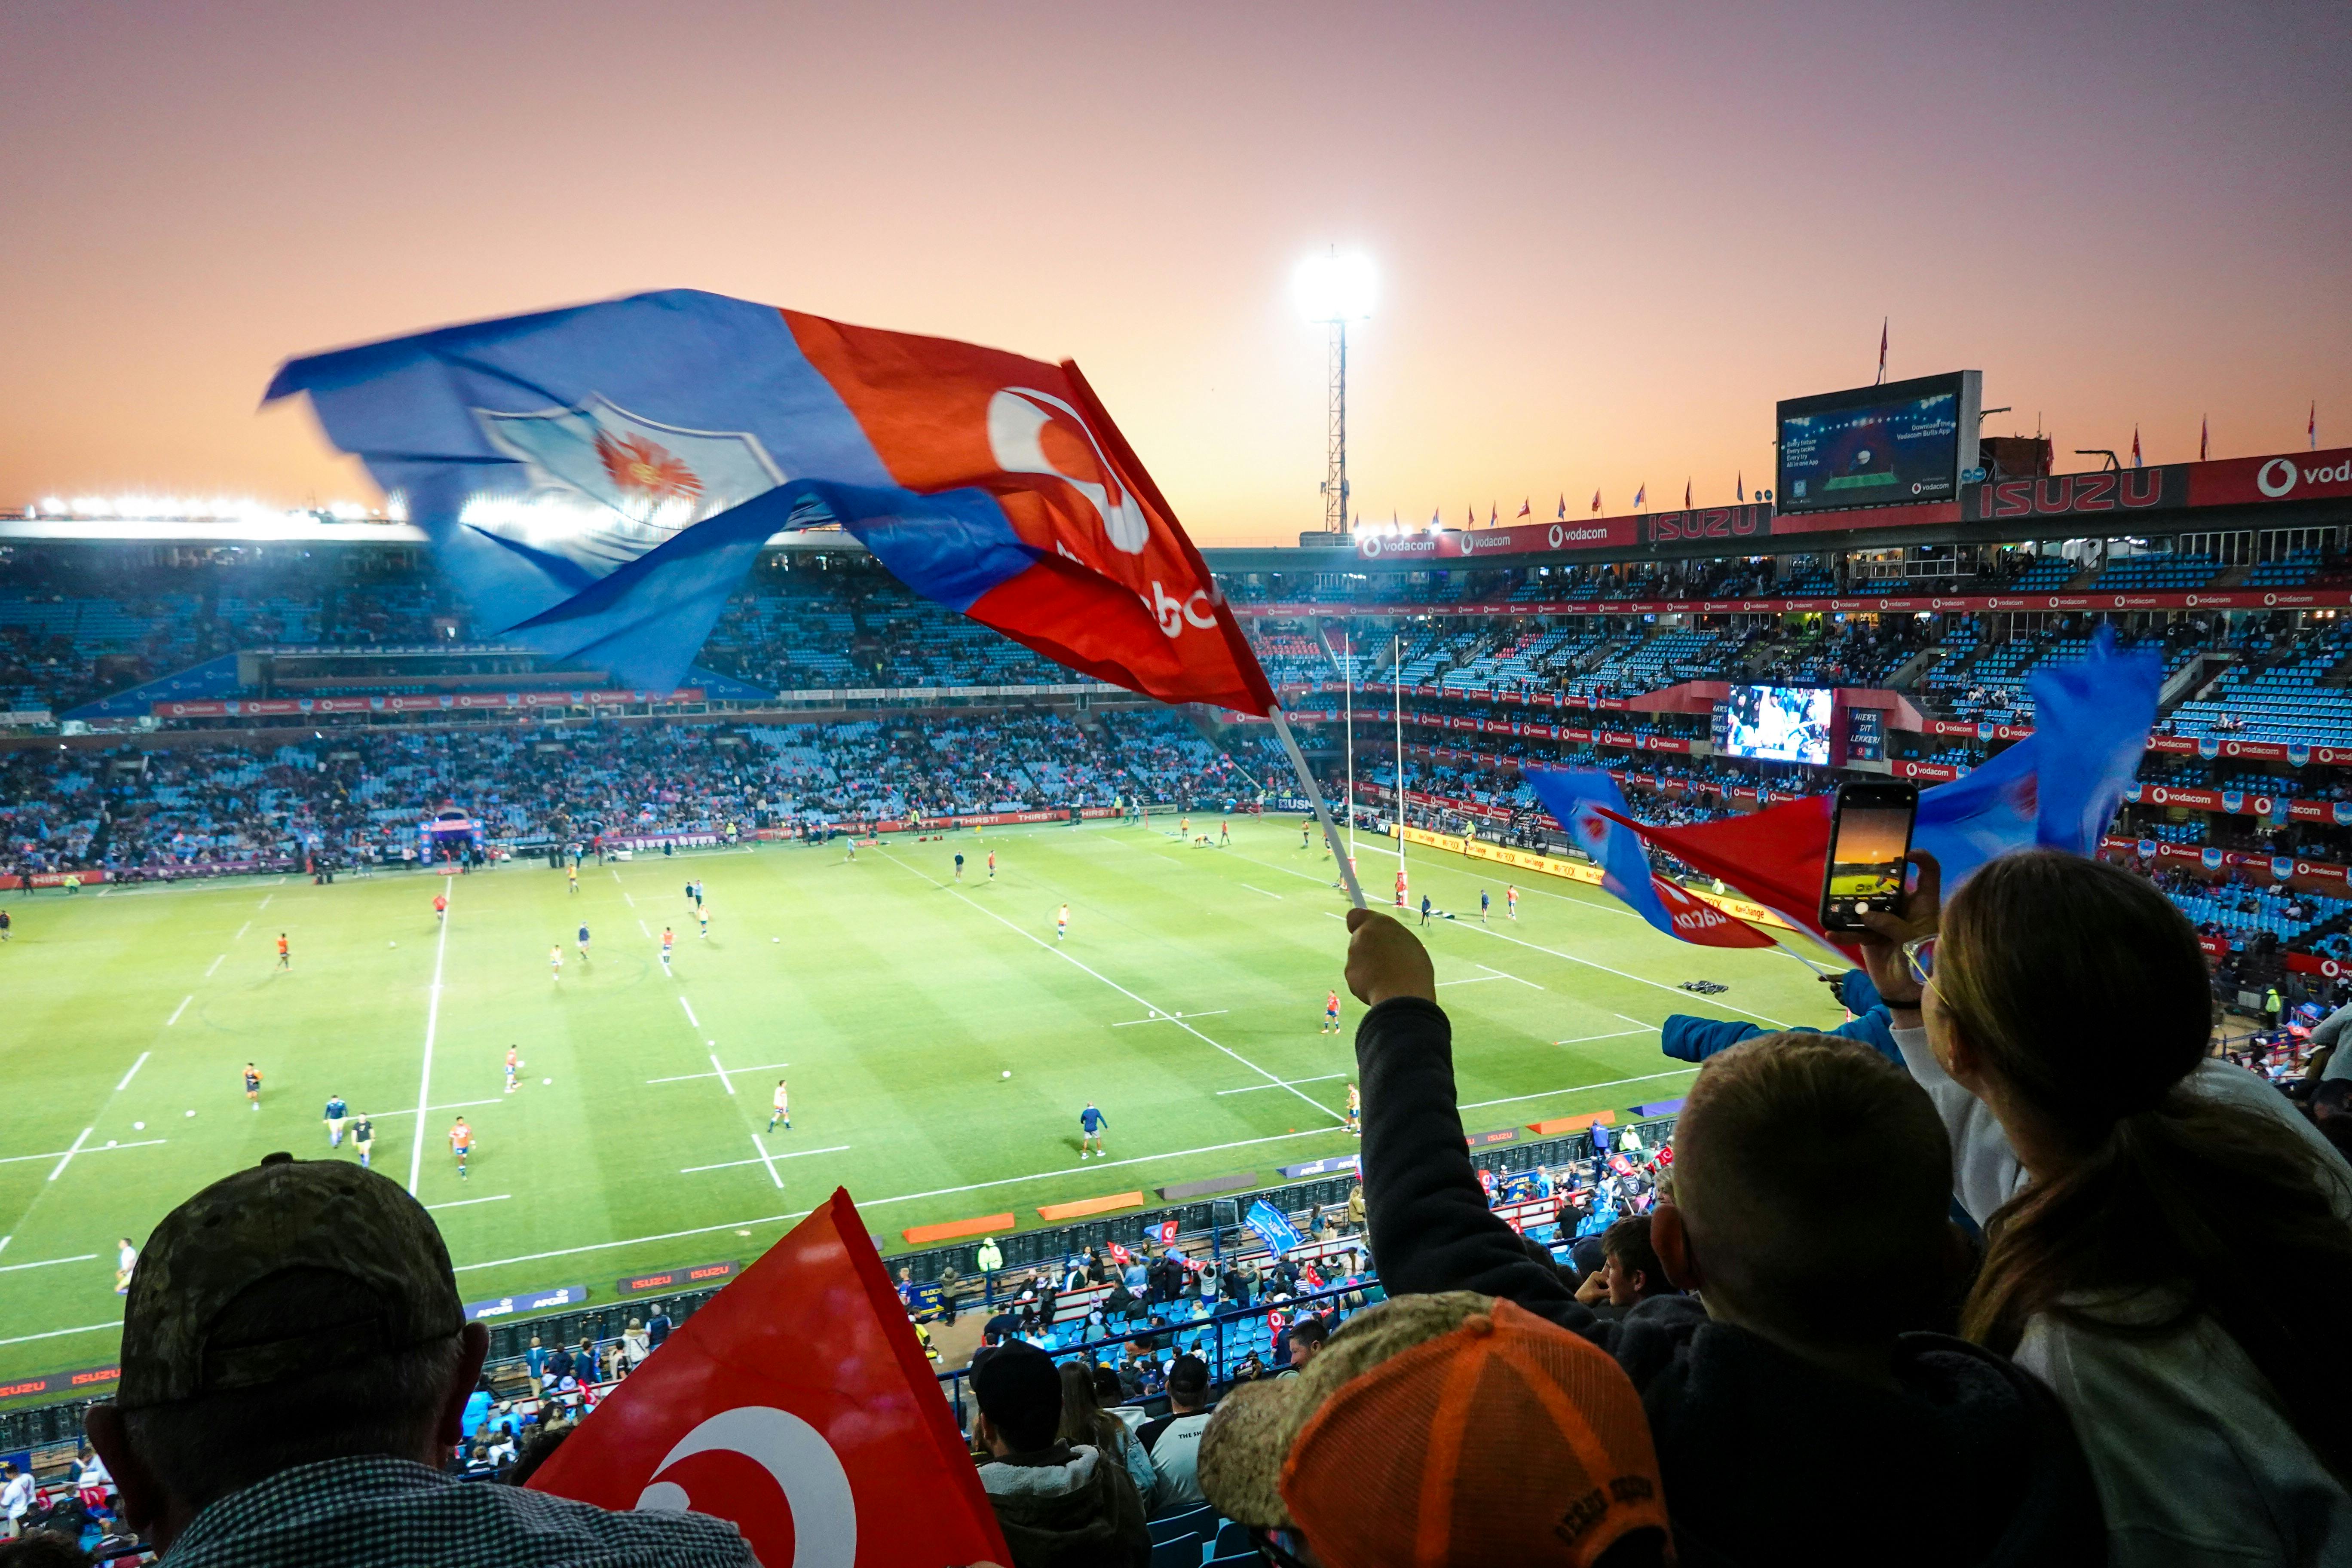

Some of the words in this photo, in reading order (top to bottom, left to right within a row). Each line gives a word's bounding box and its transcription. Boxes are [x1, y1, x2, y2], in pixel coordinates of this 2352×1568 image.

[2303, 460, 2352, 484] vod
[1980, 469, 2162, 518] ISUZU
[1649, 505, 1757, 541] ISUZU
[1565, 527, 1607, 541] vodacom
[1383, 540, 1435, 551] vodacom
[1475, 536, 1510, 547] vodacom
[1850, 735, 1880, 744] LEKKER!
[2157, 740, 2191, 748] vodacom
[2242, 746, 2279, 754] vodacom
[1918, 768, 1948, 777] vodacom
[2169, 793, 2211, 804] vodacom
[2311, 868, 2343, 876] vodacom
[1487, 1132, 1513, 1142] ISUZU
[691, 1266, 729, 1279] ISUZU
[632, 1275, 671, 1289] ISUZU
[72, 1368, 121, 1385] ISUZU
[0, 1381, 46, 1397] SUZU
